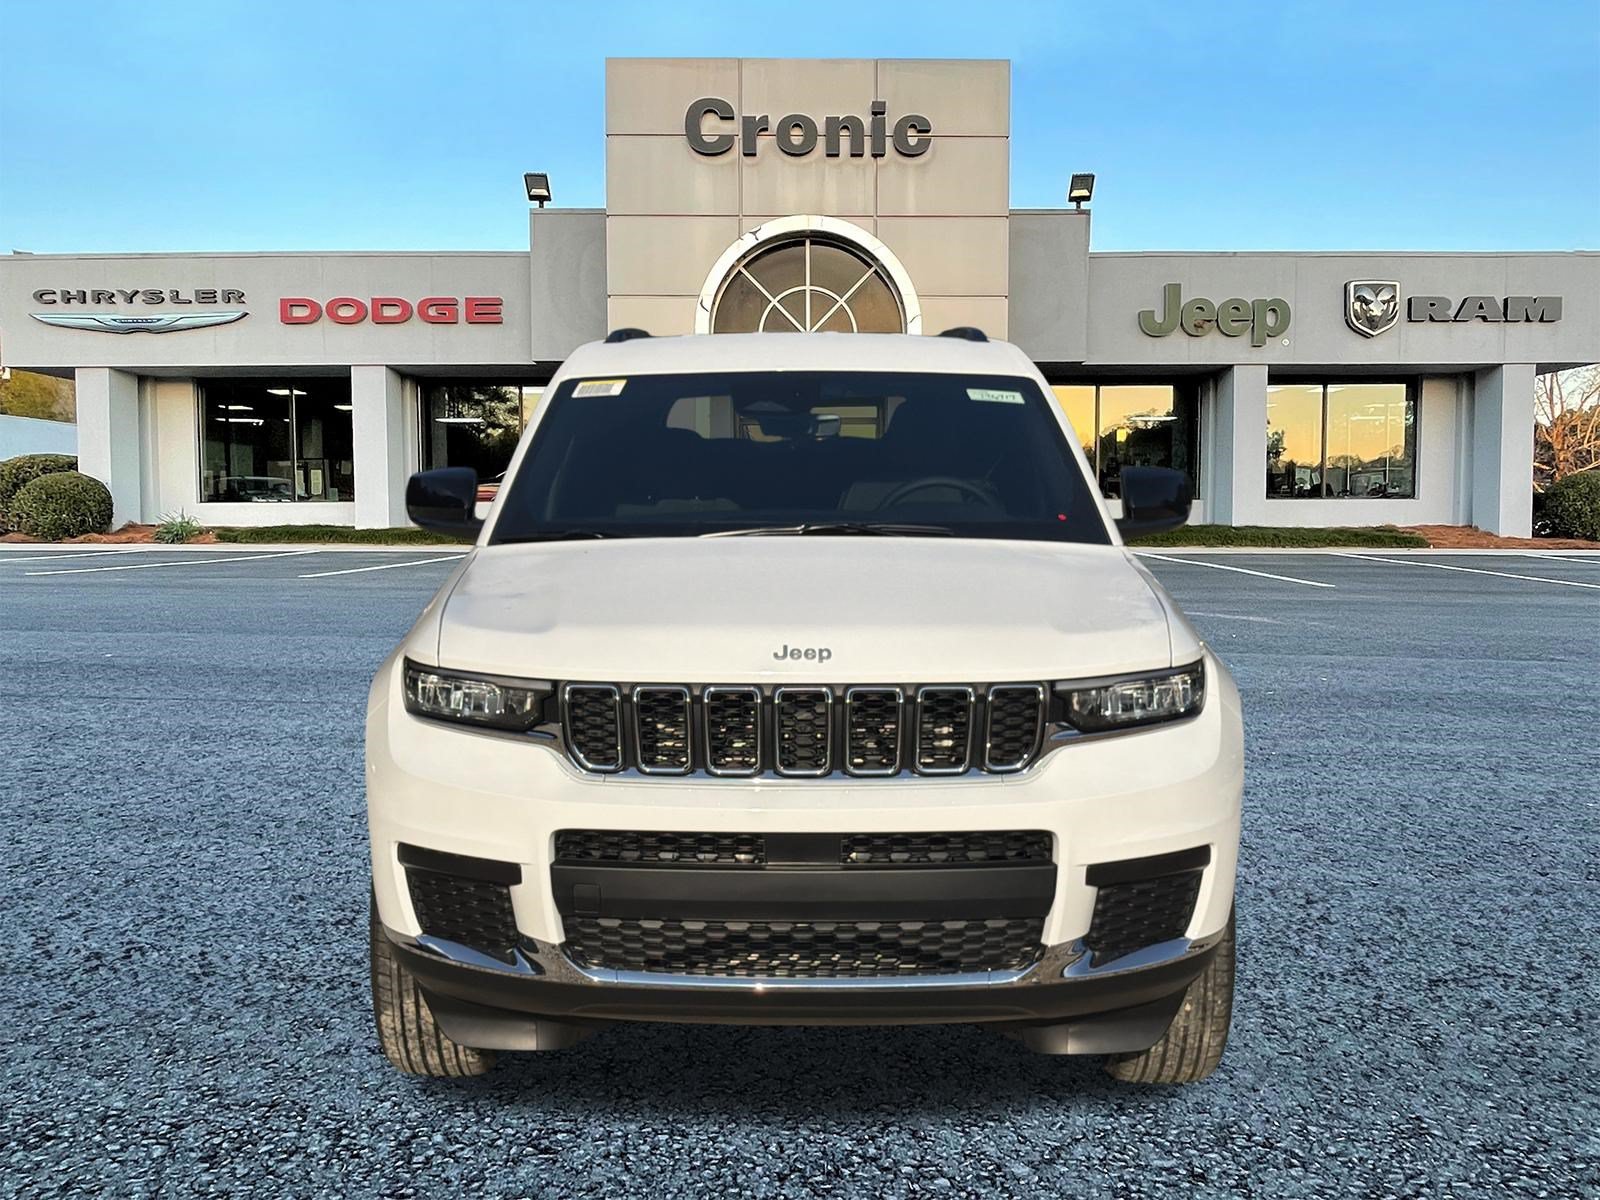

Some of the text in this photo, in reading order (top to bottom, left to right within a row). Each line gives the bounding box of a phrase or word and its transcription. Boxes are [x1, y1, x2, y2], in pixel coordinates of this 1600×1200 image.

[685, 97, 932, 157] Cronic
[32, 289, 247, 305] CHRYSLER
[1407, 296, 1563, 322] RAM
[280, 297, 503, 325] DODGE
[1138, 283, 1291, 347] Jeep
[773, 644, 832, 664] Jeep
